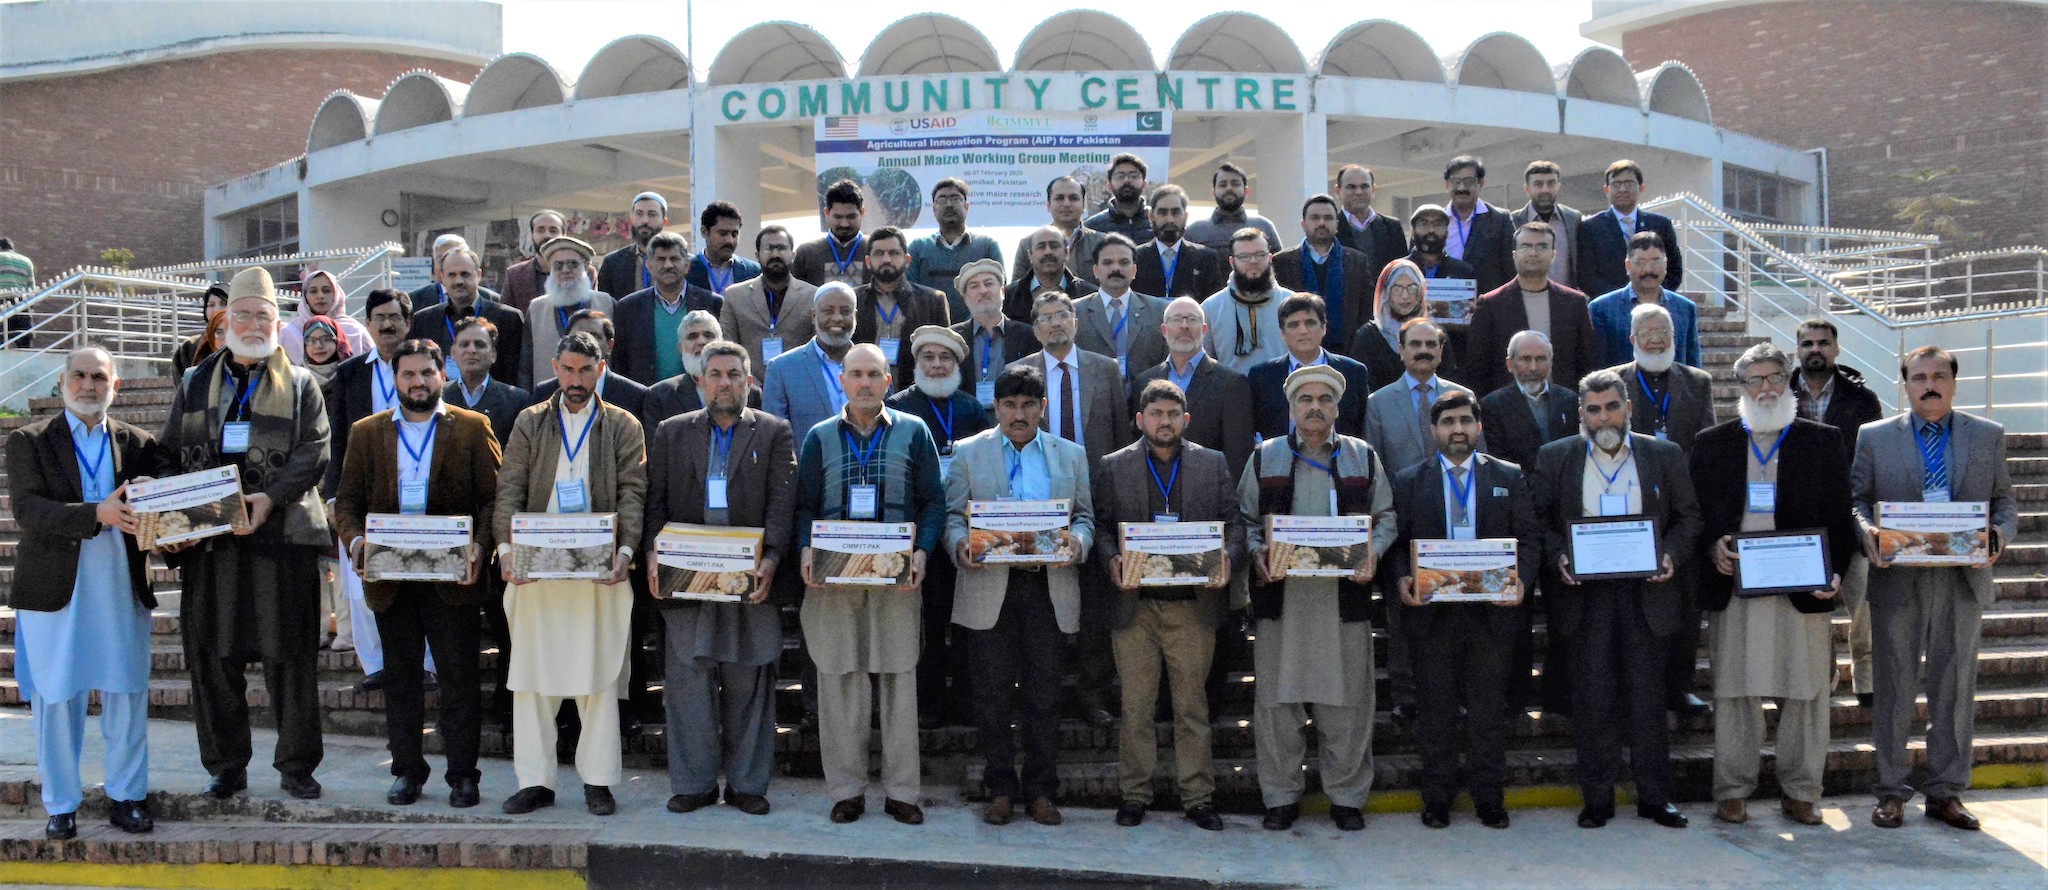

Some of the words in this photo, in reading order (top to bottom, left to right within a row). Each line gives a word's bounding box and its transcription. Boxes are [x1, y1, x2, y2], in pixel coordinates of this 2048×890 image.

[721, 77, 1052, 121] COMMUNITY
[1080, 76, 1297, 111] CENTRE
[910, 117, 957, 129] USAID
[996, 116, 1051, 127] CIMMYT
[866, 138, 927, 151] Agricultural
[930, 135, 983, 147] Innovation
[985, 136, 1031, 146] Program
[1031, 135, 1057, 147] (AIP)
[1059, 136, 1073, 145] for
[1076, 136, 1121, 145] Pakistan
[877, 156, 921, 168] Annual
[924, 153, 960, 166] Maize
[962, 153, 1015, 165] Working
[1018, 153, 1056, 165] Group
[1059, 152, 1111, 164] Meeting
[1009, 190, 1042, 198] research
[148, 501, 170, 511] Breeder
[170, 494, 208, 506] Seed/Parental
[207, 491, 224, 500] Lines
[686, 560, 725, 569] CIMMYT-PAK
